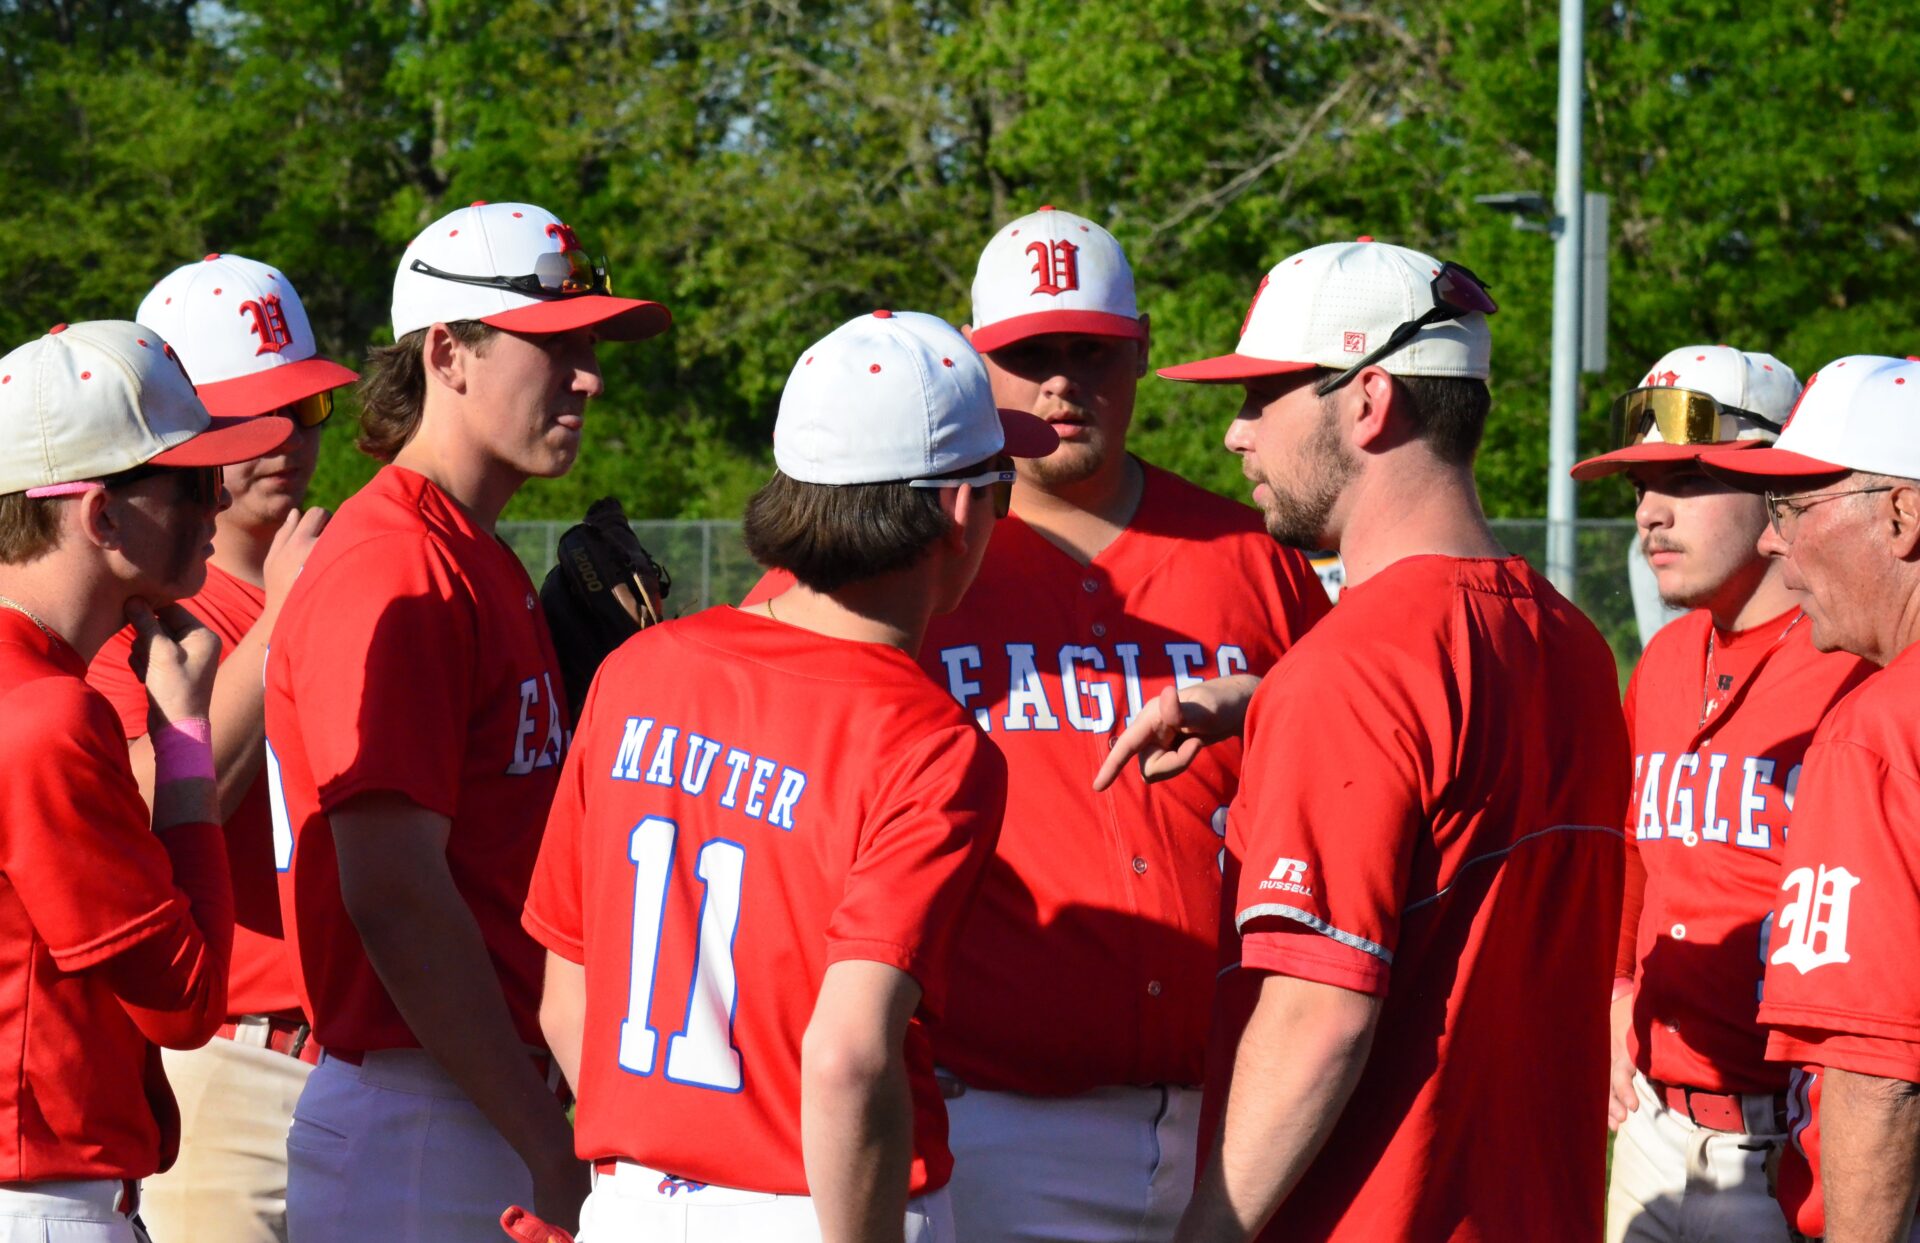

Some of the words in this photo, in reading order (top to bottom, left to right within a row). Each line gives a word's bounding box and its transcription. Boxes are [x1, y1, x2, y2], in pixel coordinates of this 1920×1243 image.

[611, 716, 808, 831] MAUTER
[1259, 880, 1313, 897] RUSSELL
[1268, 857, 1308, 884] R
[618, 814, 746, 1093] 11
